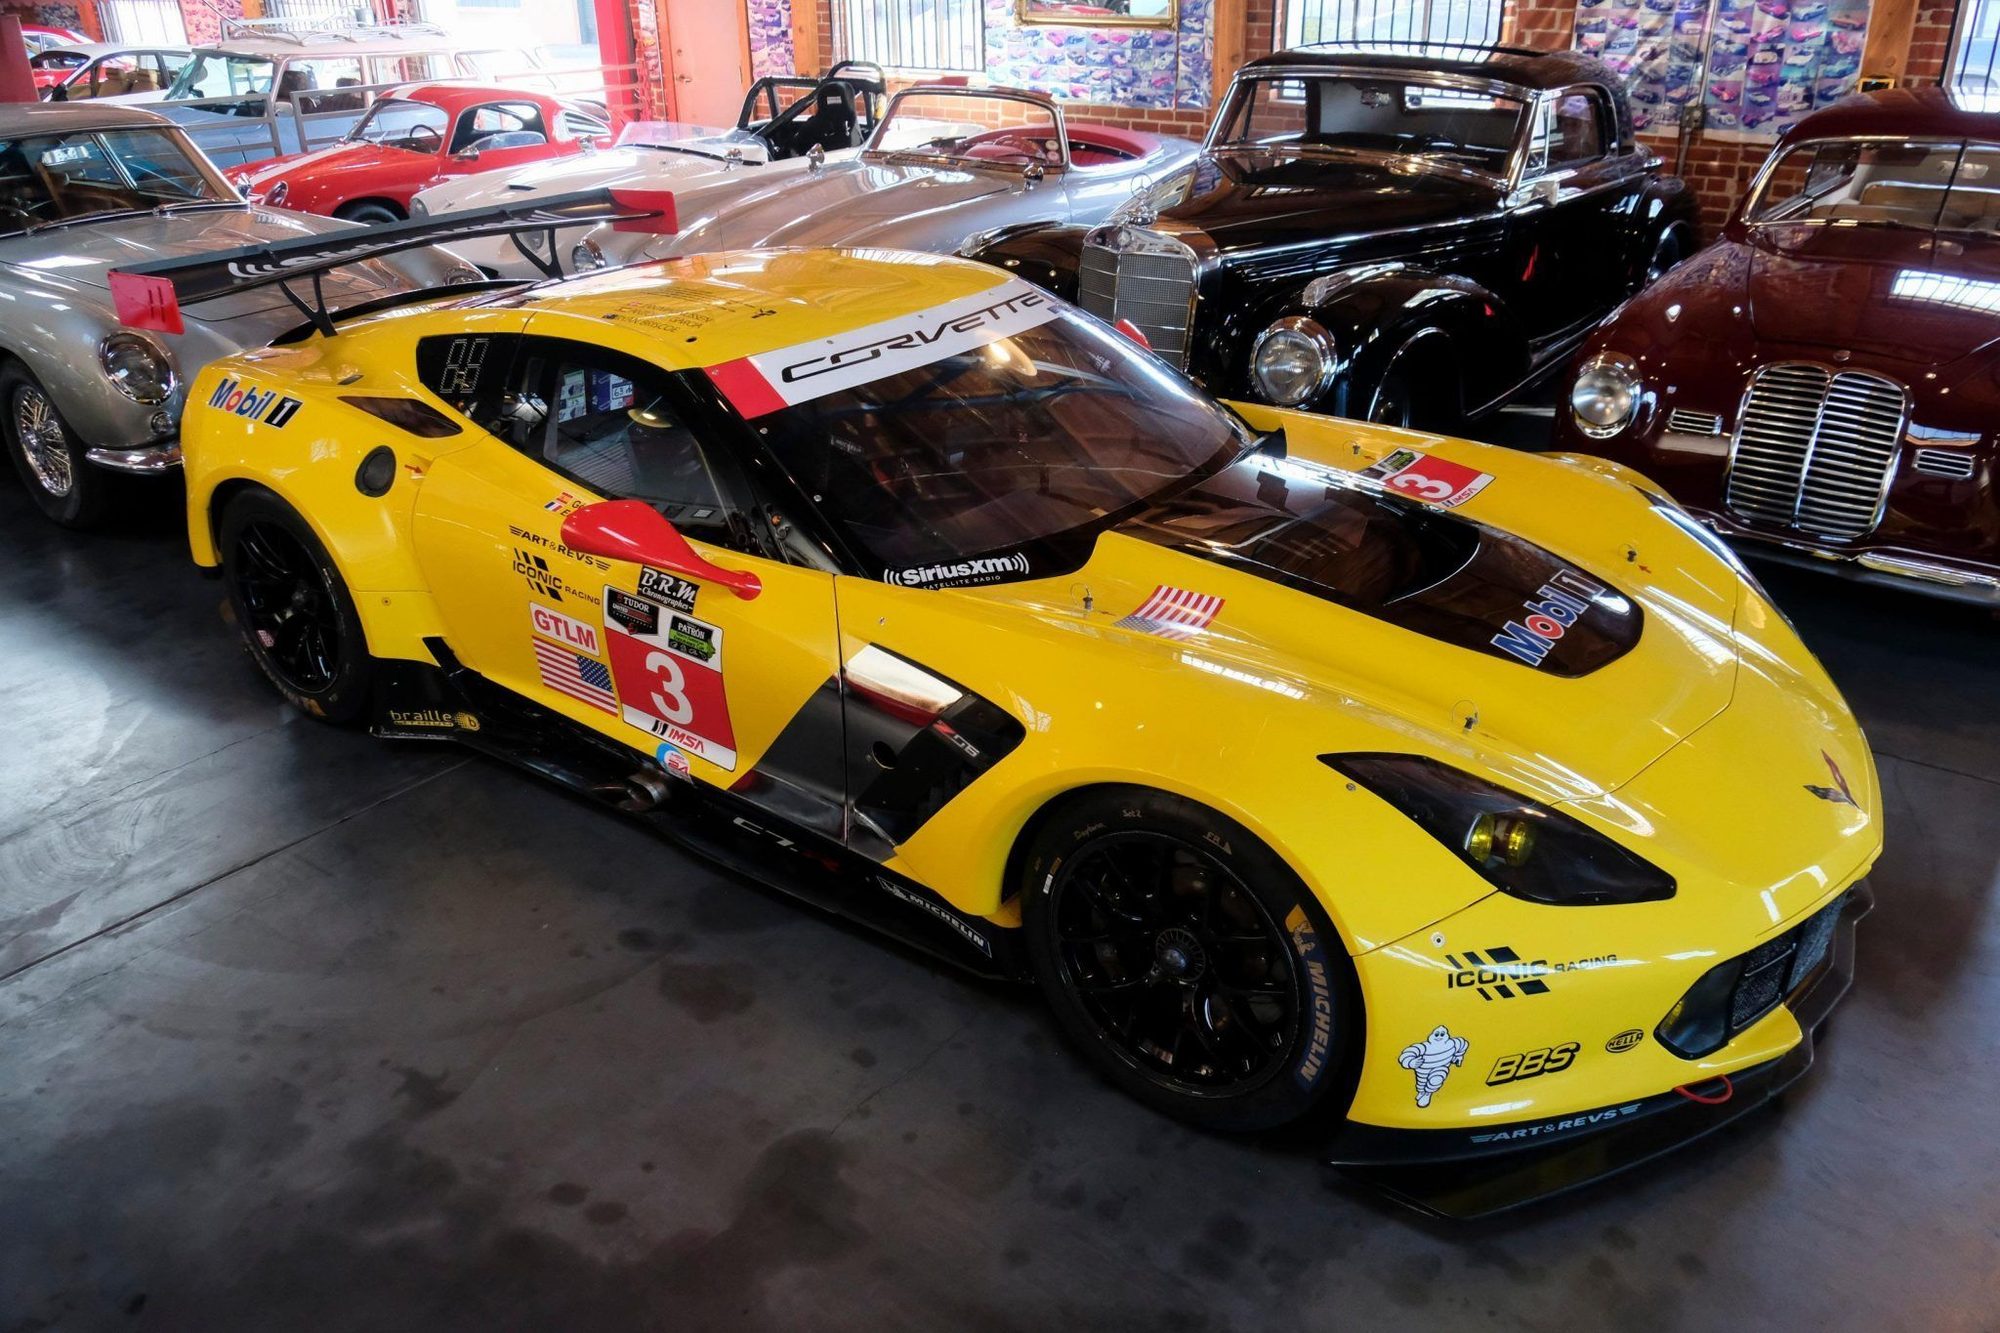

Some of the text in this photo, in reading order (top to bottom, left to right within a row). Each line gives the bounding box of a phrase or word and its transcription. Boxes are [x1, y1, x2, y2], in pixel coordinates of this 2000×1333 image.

[782, 291, 1044, 383] CORVETTE
[208, 378, 277, 420] Mobil
[1392, 474, 1453, 498] 3
[521, 530, 594, 566] ART&REVS
[513, 559, 601, 605] ICONIC RACING
[922, 575, 1001, 590] SATELLITE RADIO
[623, 597, 650, 613] TUDOR
[534, 609, 597, 651] GTLM
[1490, 584, 1591, 667] Mobil
[645, 651, 693, 725] 3
[390, 705, 452, 722] braille
[668, 728, 704, 754] IMSA
[909, 894, 985, 947] MICHELIN
[1447, 954, 1618, 989] ICONIC RACING
[1301, 960, 1332, 1083] MICHELIN
[1607, 1030, 1645, 1050] HELLA
[1485, 1041, 1581, 1087] BBS
[1491, 1109, 1618, 1142] ART&REVS
